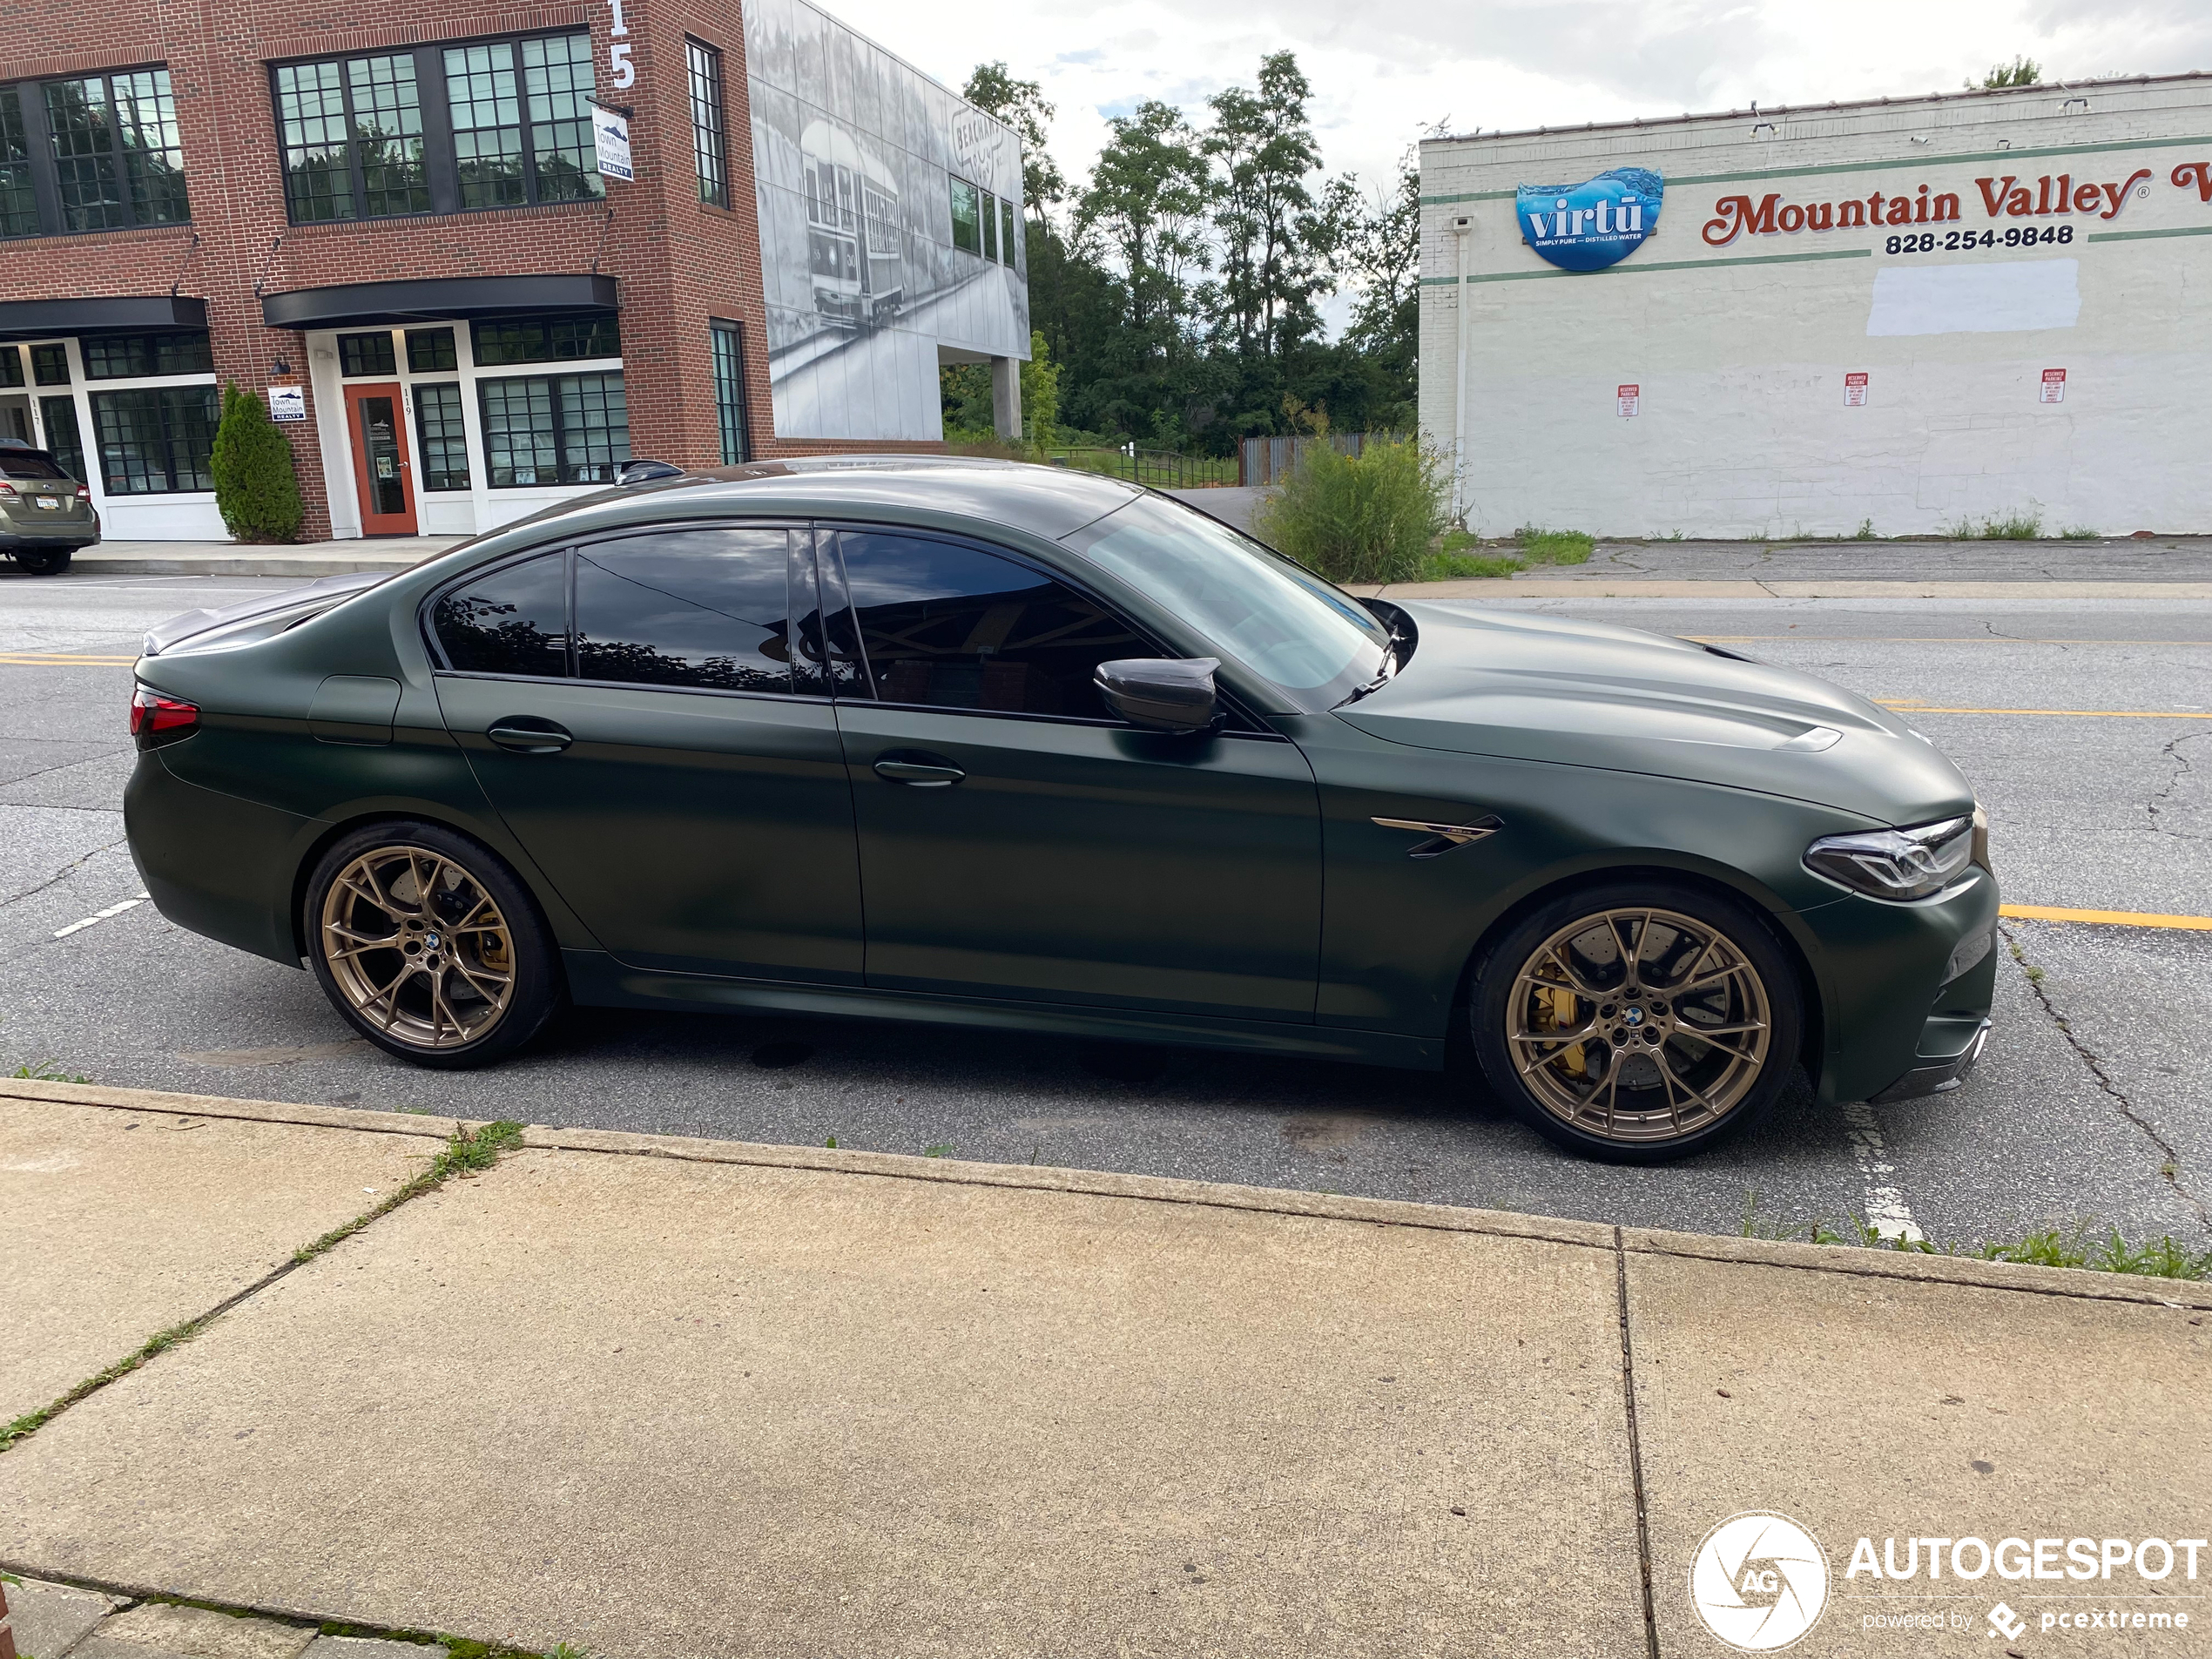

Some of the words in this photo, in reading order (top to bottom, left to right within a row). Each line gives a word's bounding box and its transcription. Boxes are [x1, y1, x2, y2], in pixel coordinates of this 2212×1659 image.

[595, 124, 617, 146] Town
[597, 145, 631, 165] Mountain
[603, 160, 629, 176] REALTY
[1527, 196, 1644, 239] virtū
[1702, 185, 1961, 247] Mountain
[1975, 168, 2153, 220] Valley
[1535, 238, 1558, 246] SIMPLY
[1885, 225, 2074, 255] 828-254-9848
[271, 396, 290, 405] Town
